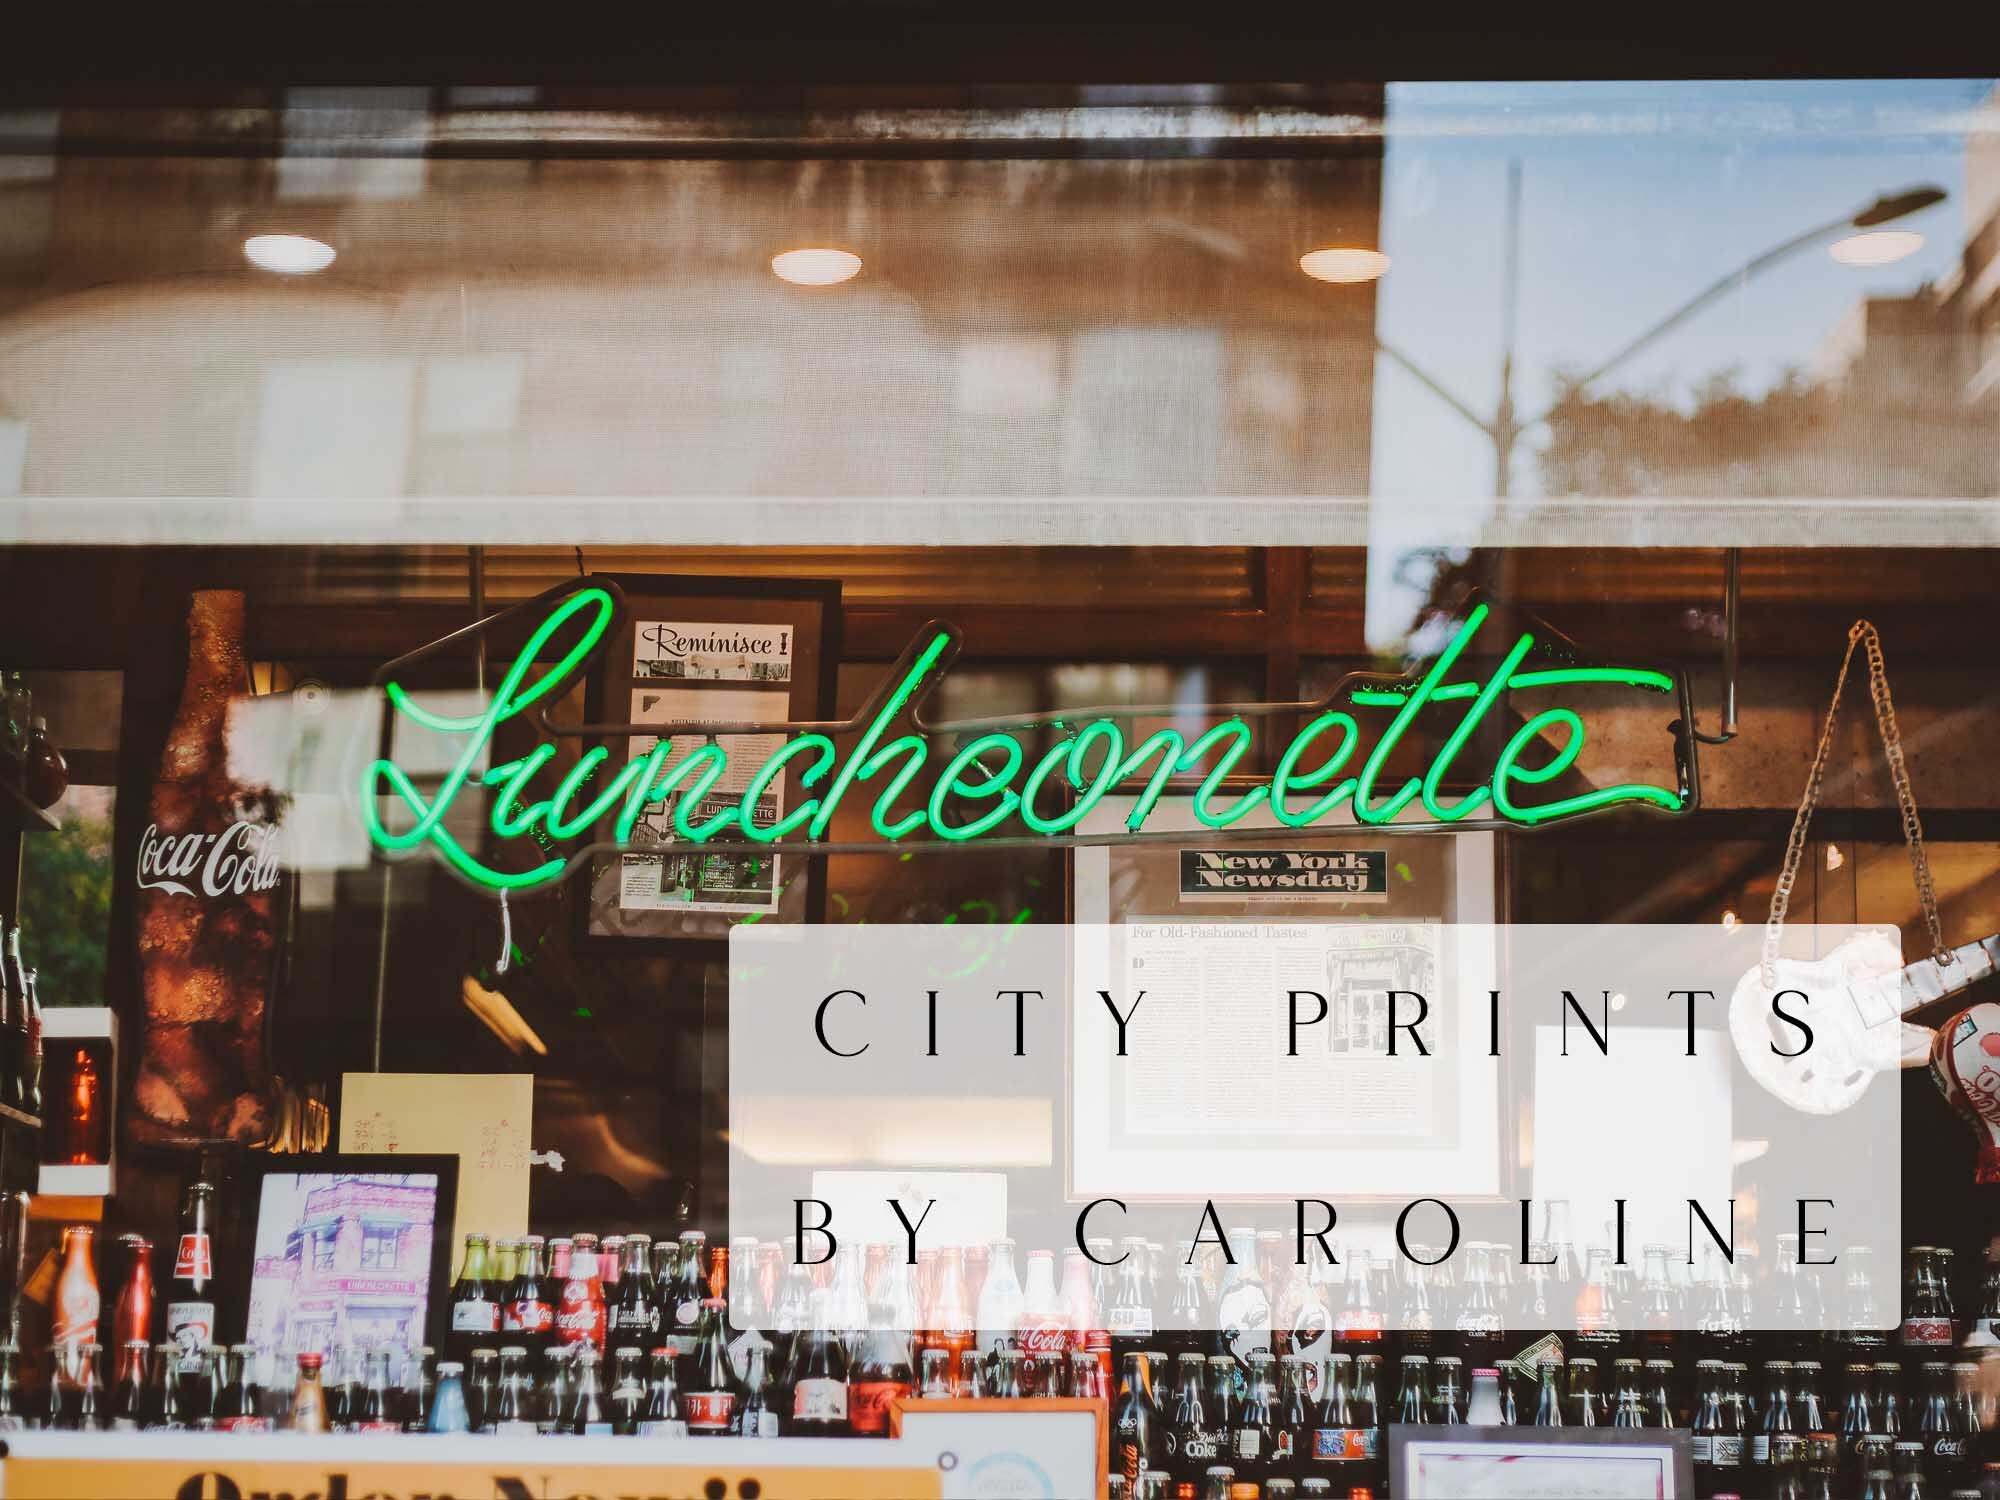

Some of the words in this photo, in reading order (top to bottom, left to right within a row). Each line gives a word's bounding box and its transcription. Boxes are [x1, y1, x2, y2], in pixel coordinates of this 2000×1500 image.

[642, 624, 772, 658] Reminisce
[361, 587, 1682, 889] Luncheonette
[137, 821, 280, 898] Coca-Cola
[1195, 852, 1279, 869] New
[1285, 852, 1370, 869] York
[1195, 869, 1369, 891] Newsday
[1132, 926, 1154, 938] For
[1159, 925, 1258, 938] Old-Fashioned
[1263, 926, 1309, 938] Tastes
[1185, 1440, 1217, 1457] Coke
